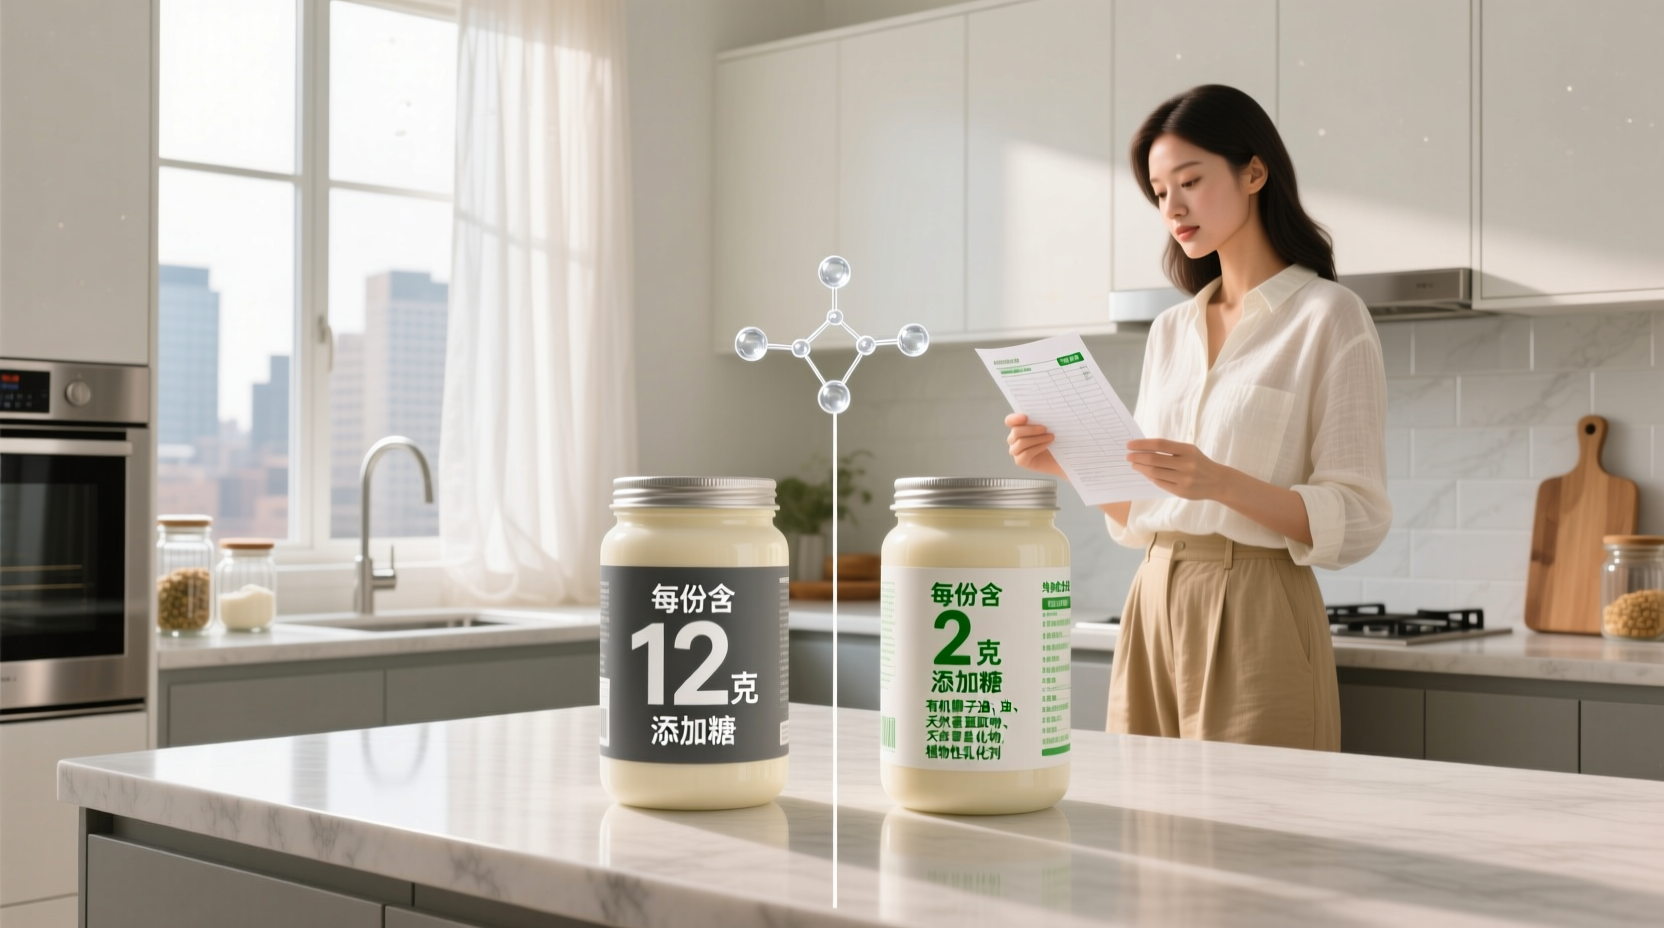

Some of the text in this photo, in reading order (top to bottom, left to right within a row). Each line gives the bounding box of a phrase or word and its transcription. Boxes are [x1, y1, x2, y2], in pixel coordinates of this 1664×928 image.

[651, 583, 736, 614] 每份含
[931, 582, 1003, 607] 每份含
[931, 670, 1003, 693] 添加糖
[651, 715, 737, 746] 添加糖
